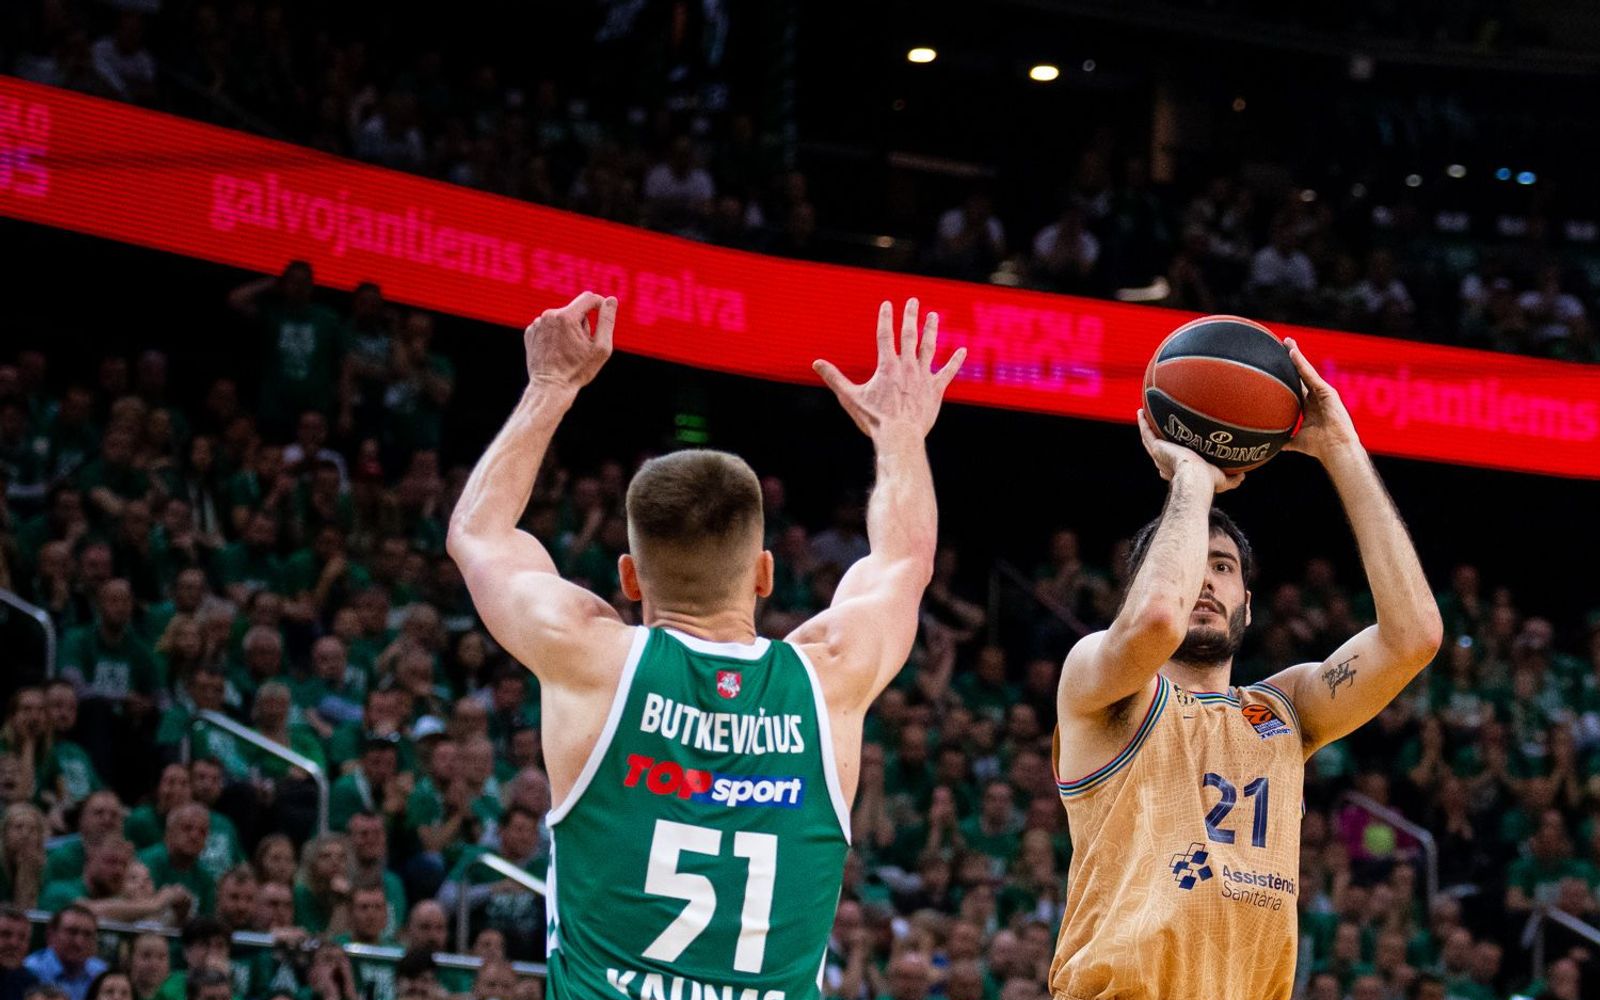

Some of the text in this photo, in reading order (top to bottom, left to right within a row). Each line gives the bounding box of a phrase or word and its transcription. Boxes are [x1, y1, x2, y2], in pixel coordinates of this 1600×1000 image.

[210, 173, 746, 332] galvojantiems savo galva
[1323, 358, 1598, 440] vojantiems
[1163, 413, 1271, 462] SPALDING
[640, 693, 805, 755] BUTKEVIČIUS
[1203, 772, 1269, 848] 21
[642, 819, 778, 974] 51
[1221, 880, 1283, 911] Sanitària
